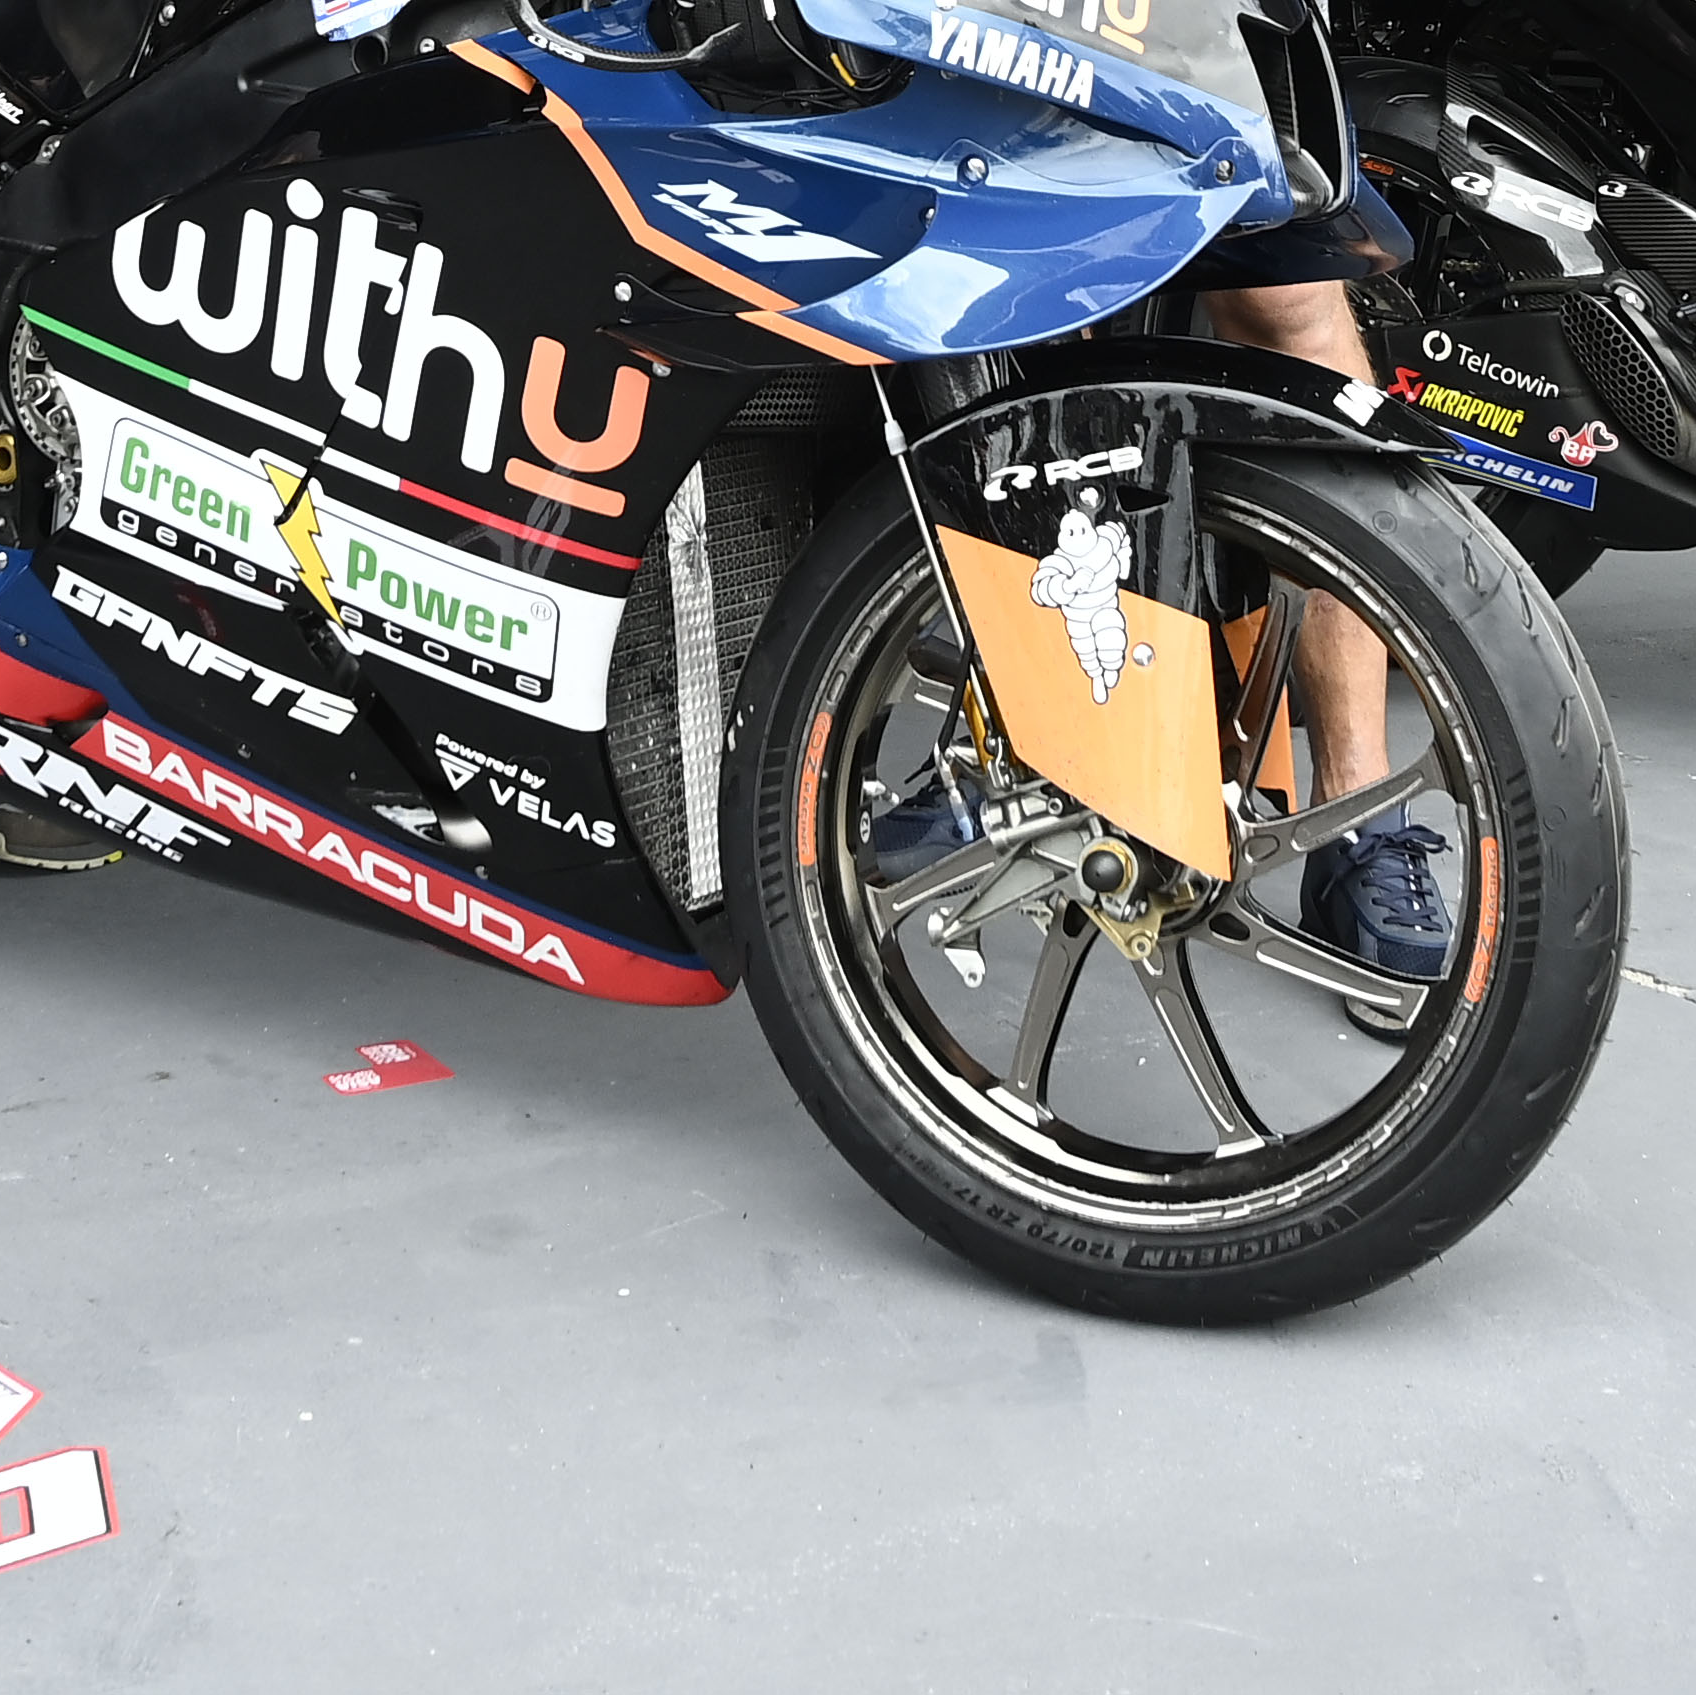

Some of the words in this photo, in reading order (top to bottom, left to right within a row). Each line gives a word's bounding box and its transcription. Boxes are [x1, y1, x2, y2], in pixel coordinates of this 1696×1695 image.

[927, 11, 1097, 109] YAMAHA
[1457, 346, 1559, 398] Telcowin
[1045, 445, 1143, 487] RCB
[1442, 452, 1574, 494] ICHELIN
[1563, 439, 1595, 461] BP
[119, 435, 254, 545] Green
[346, 539, 530, 653] Power
[52, 566, 359, 735] GPNFTS
[435, 732, 516, 781] powered
[518, 763, 548, 792] by
[58, 796, 188, 864] RACING
[103, 717, 587, 988] BARRACUDA
[1026, 1221, 1115, 1261] 120/70
[1140, 1227, 1303, 1267] MICHELIN
